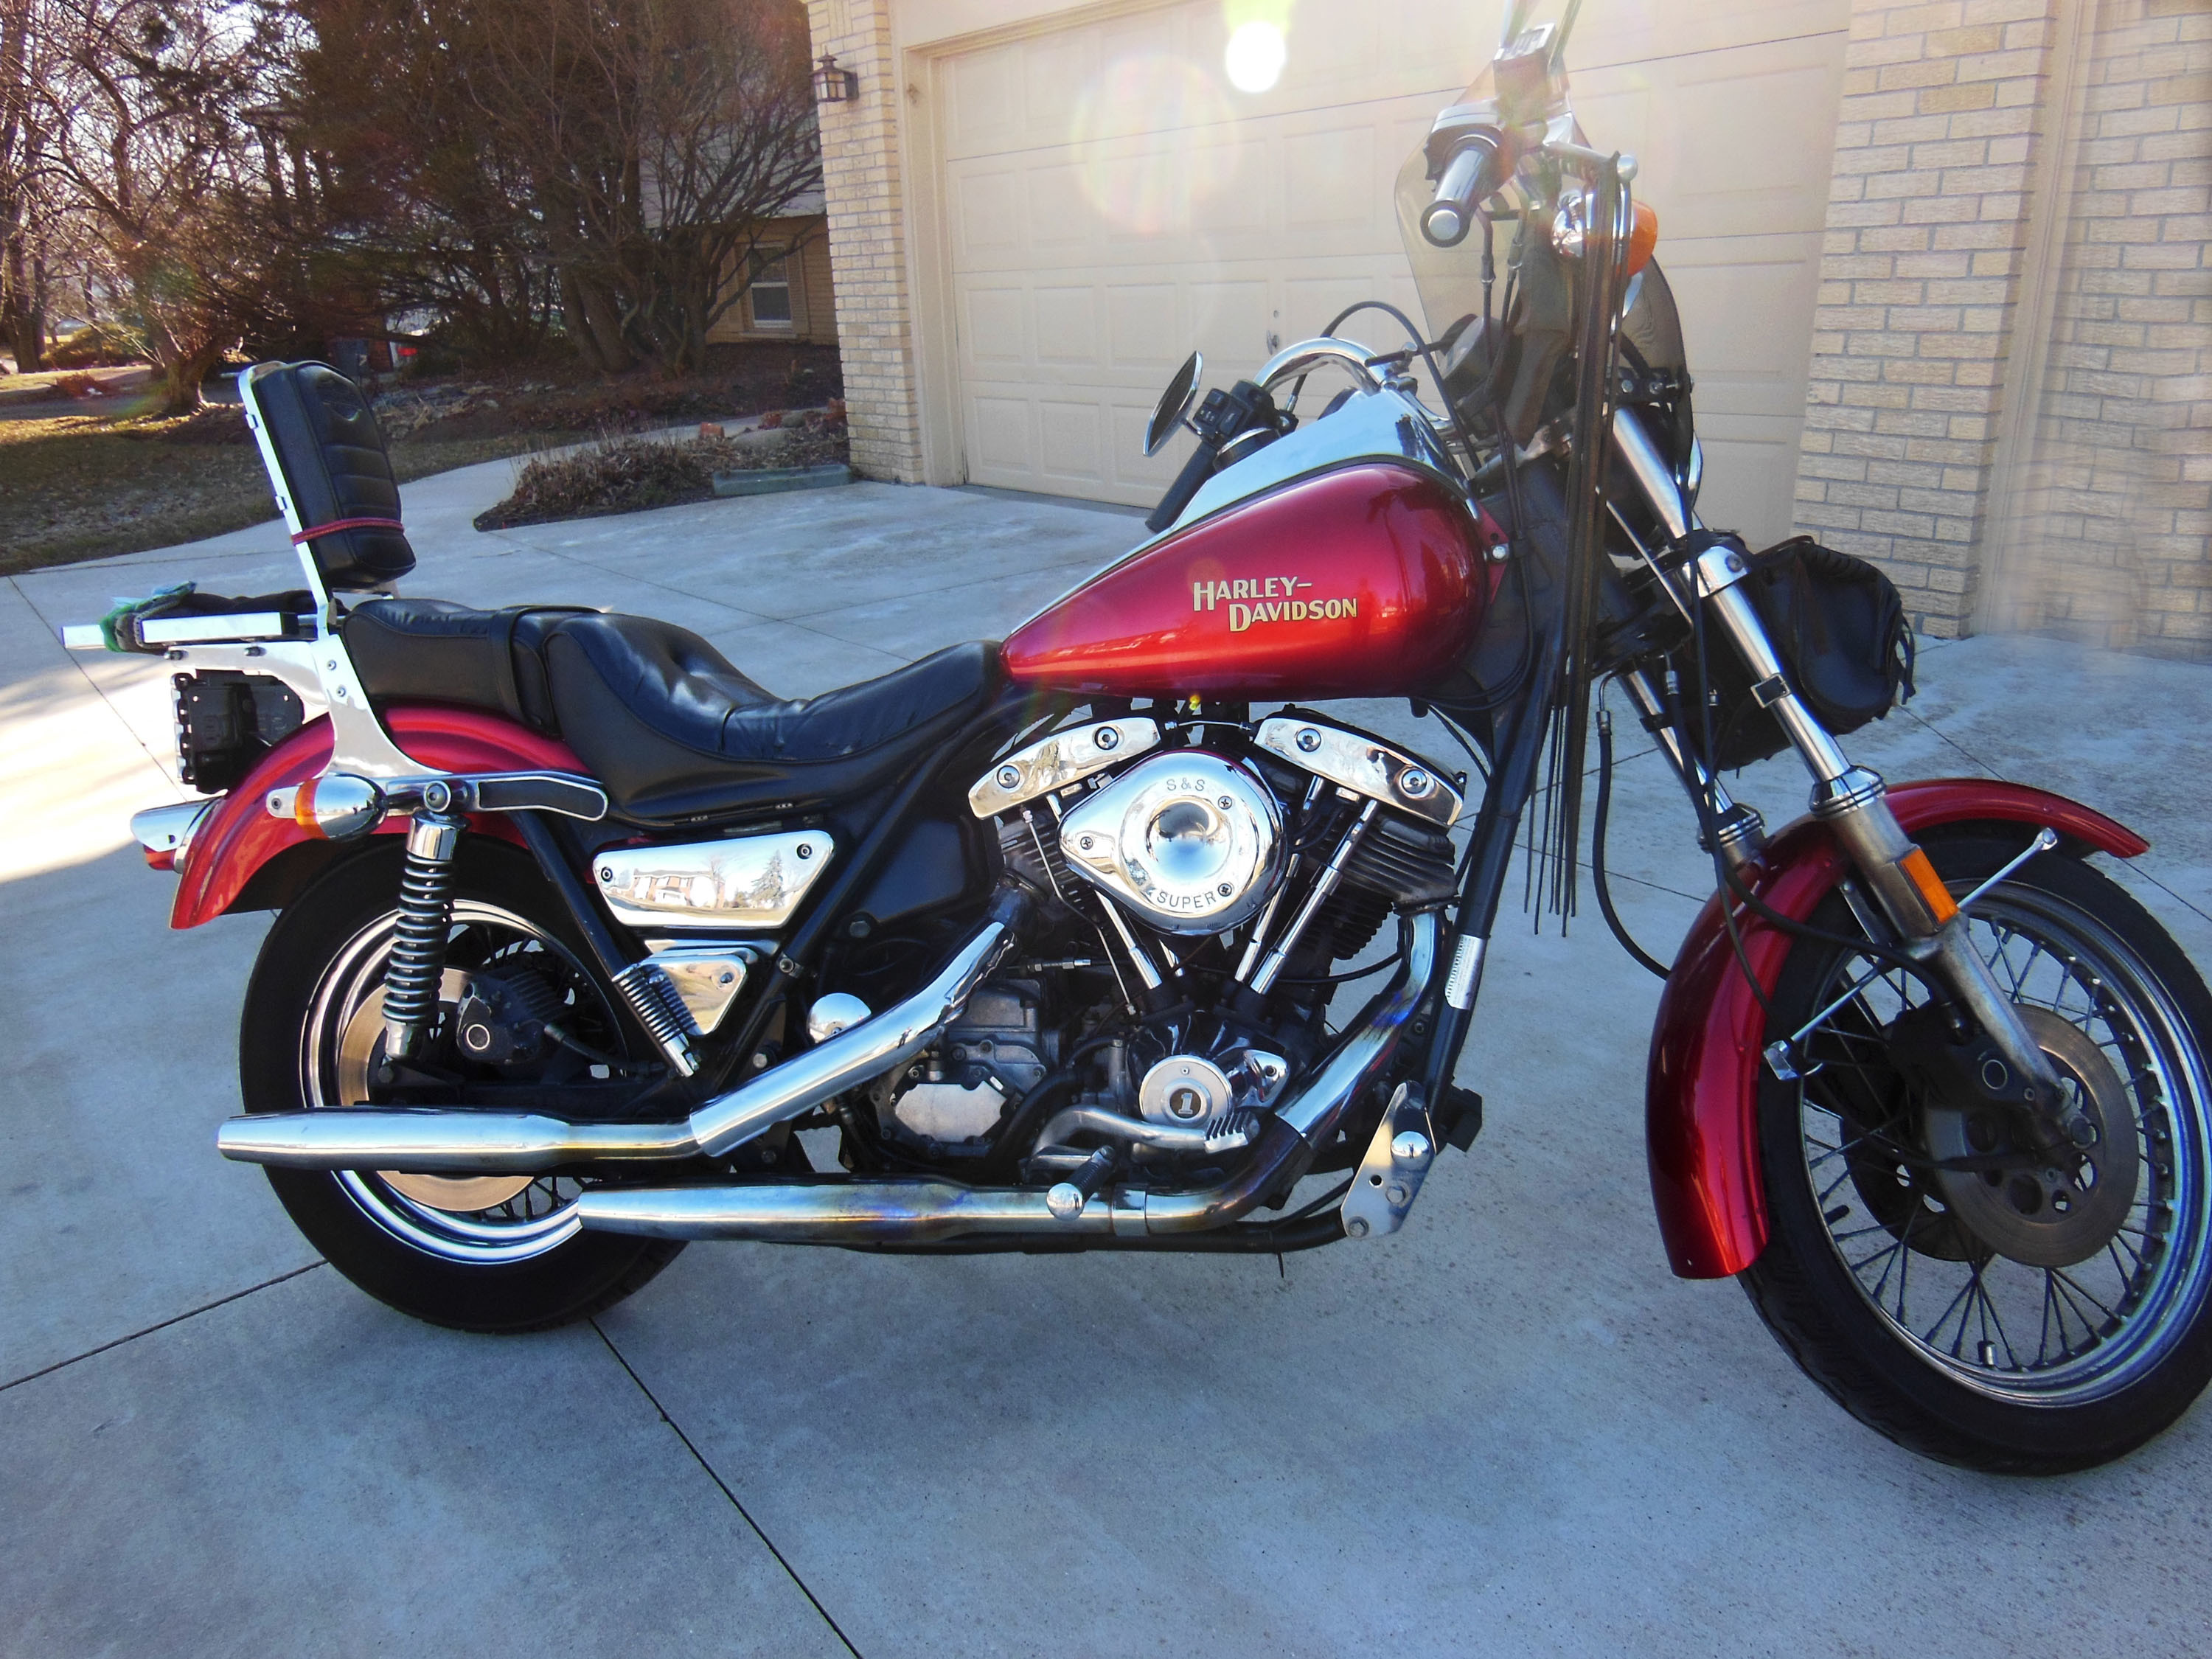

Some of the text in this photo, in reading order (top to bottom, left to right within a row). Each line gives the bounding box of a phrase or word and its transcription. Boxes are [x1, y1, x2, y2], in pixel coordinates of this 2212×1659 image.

[1228, 597, 1357, 633] DAVIDSON
[1156, 890, 1217, 909] SUPER
[1178, 1093, 1192, 1114] 1
